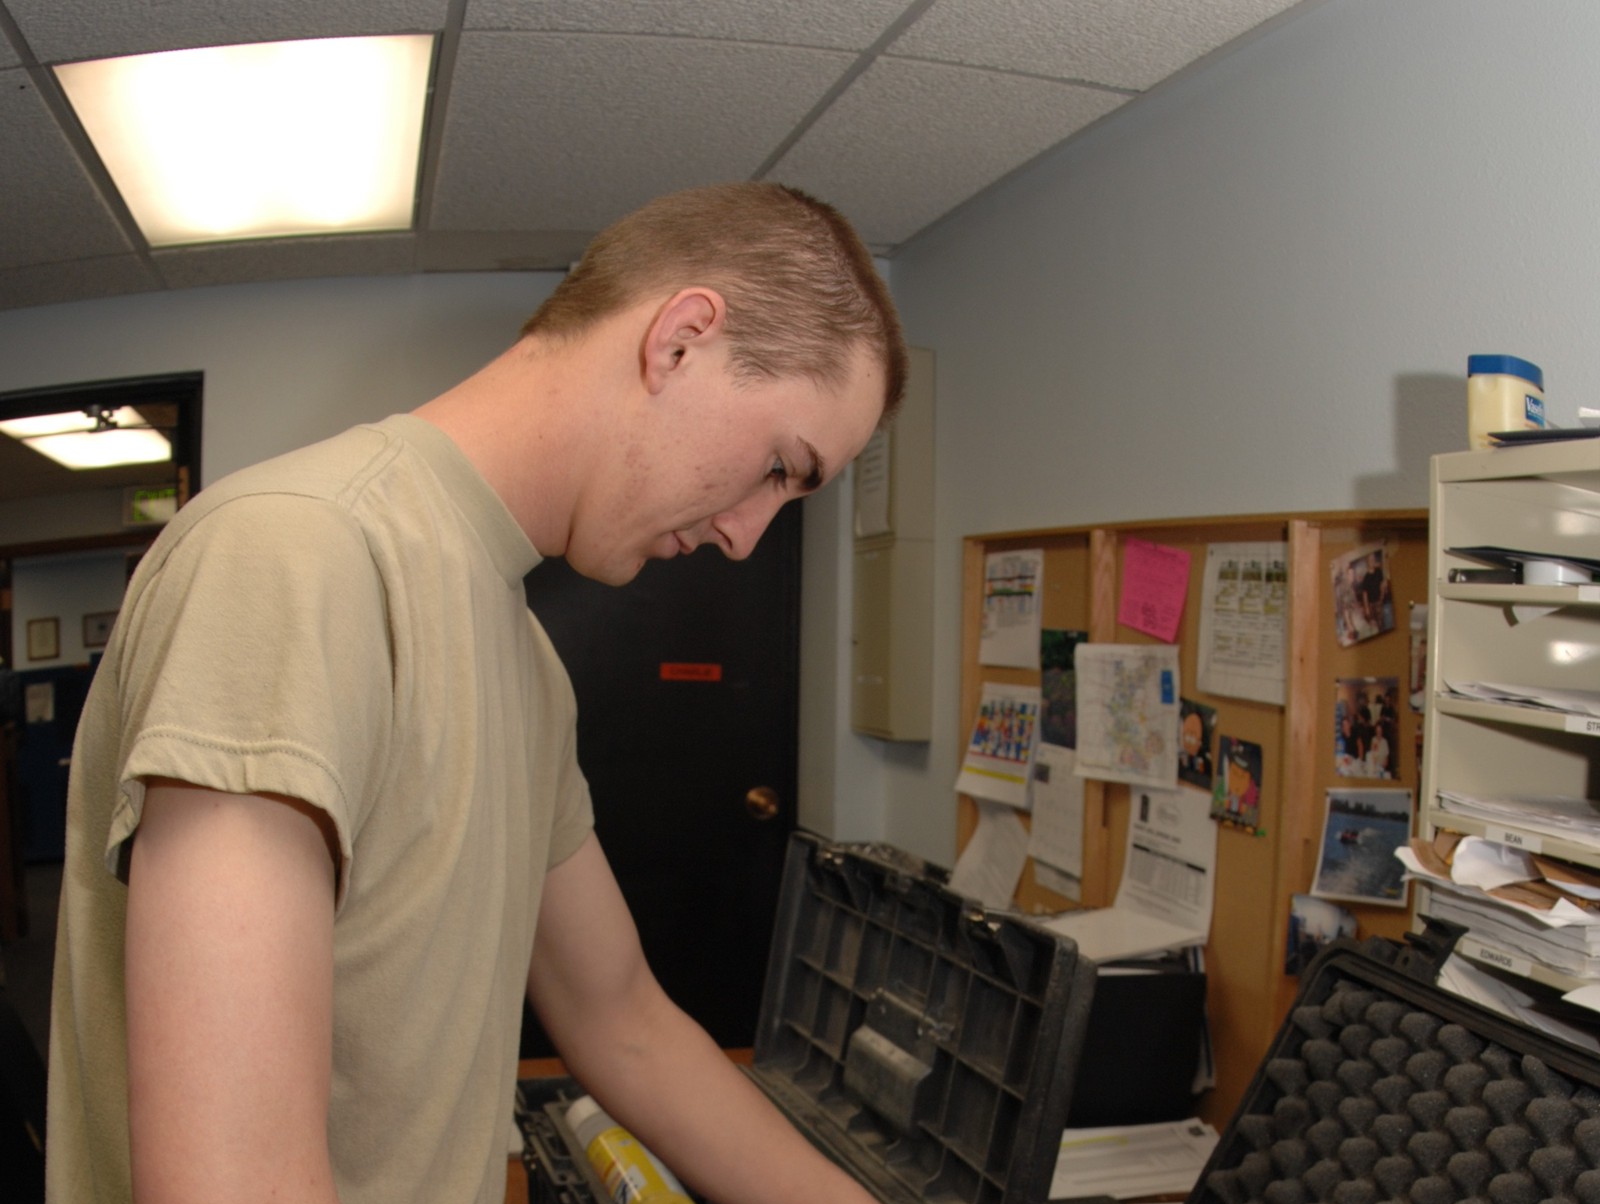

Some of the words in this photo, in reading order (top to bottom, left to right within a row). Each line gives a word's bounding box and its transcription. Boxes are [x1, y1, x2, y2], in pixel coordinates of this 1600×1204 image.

[133, 489, 177, 521] EXIT
[1504, 832, 1523, 845] BEAN
[1480, 948, 1512, 968] EDWARDS
